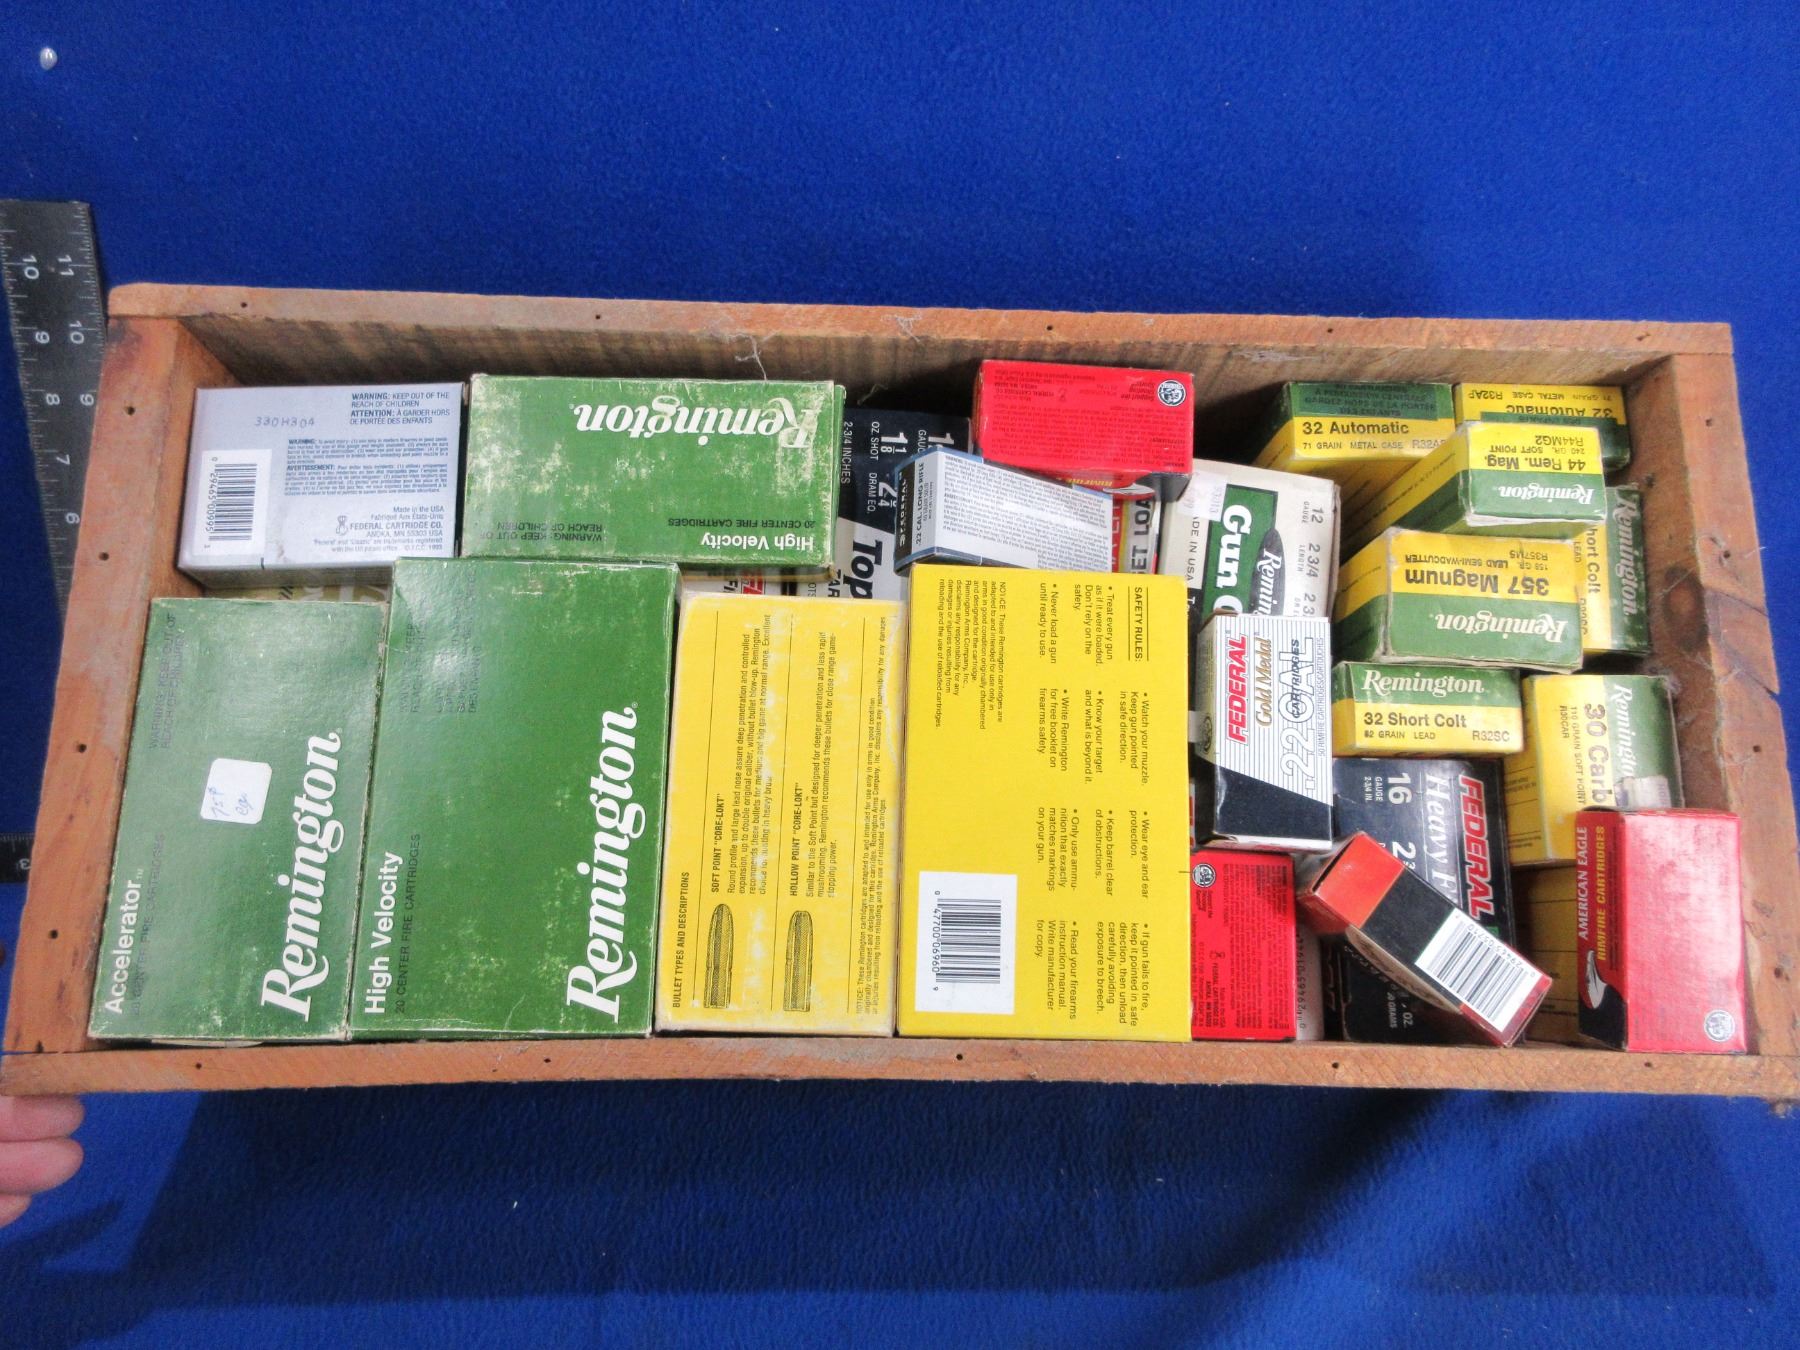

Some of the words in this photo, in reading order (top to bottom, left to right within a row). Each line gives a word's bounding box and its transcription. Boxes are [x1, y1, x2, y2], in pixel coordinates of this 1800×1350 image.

[22, 254, 40, 280] 10
[57, 254, 75, 278] 11
[35, 331, 51, 345] 9
[68, 320, 85, 345] 10
[45, 393, 61, 406] 8
[79, 393, 95, 406] 9
[351, 400, 375, 409] REACH
[376, 400, 385, 408] OF
[386, 400, 421, 408] CHILDREN
[352, 392, 392, 401] WARNING:
[392, 391, 410, 400] KEEP
[411, 391, 426, 400] OUT
[426, 391, 436, 400] OF
[437, 391, 450, 400] THE
[1511, 391, 1533, 400] CASE
[1538, 392, 1565, 400] METAL
[573, 394, 826, 448] Remington
[843, 421, 854, 446] 2-3/4
[1302, 422, 1323, 435] 32
[1329, 421, 1409, 435] Automatic
[870, 437, 880, 461] SHOT
[1303, 442, 1312, 450] 71
[1316, 442, 1342, 450] GRAIN
[1350, 442, 1377, 450] METAL
[1381, 442, 1403, 450] CASE
[1489, 445, 1517, 453] POINT
[1521, 446, 1543, 454] SOFT
[1535, 435, 1584, 446] R44MG2
[56, 454, 71, 466] 7
[841, 447, 852, 485] INCHES
[1484, 454, 1519, 470] Mag.
[1524, 458, 1562, 471] Rem.
[1567, 459, 1586, 471] 44
[867, 472, 878, 497] DRAM
[1499, 483, 1595, 506] Remington
[916, 484, 924, 511] LONG
[668, 518, 733, 528] CARTRIDGES
[736, 519, 758, 529] FIRE
[761, 520, 802, 529] CENTER
[804, 520, 816, 529] 20
[1301, 501, 1310, 524] GAUGE
[1311, 507, 1324, 524] 12
[350, 522, 383, 531] FEDERAL
[385, 521, 429, 530] CARTRIDGE
[700, 532, 769, 551] Velocity
[774, 533, 814, 551] High
[1190, 543, 1199, 554] IN
[1215, 504, 1252, 589] Gun
[1587, 527, 1601, 559] hort
[842, 540, 882, 599] Top
[1131, 545, 1148, 574] ET
[1296, 544, 1305, 572] LENGTH
[1405, 554, 1483, 566] SEMI-WADCUTTER
[1485, 559, 1508, 569] LEAD
[1612, 498, 1638, 616] Remington
[1186, 559, 1197, 582] USA
[1405, 568, 1498, 594] Magnum
[1585, 562, 1600, 593] Colt
[1084, 584, 1093, 609] Don't
[1507, 575, 1549, 596] 357
[1050, 591, 1058, 618] Never
[1106, 594, 1114, 615] Treat
[1134, 587, 1143, 624] SAFETY
[1050, 619, 1058, 638] load
[1083, 610, 1093, 626] rely
[1105, 617, 1114, 642] every
[1434, 611, 1568, 643] Remington
[1084, 627, 1092, 639] on
[1134, 626, 1143, 662] RULES:
[1049, 647, 1057, 664] gun
[1084, 640, 1093, 655] the
[1105, 643, 1113, 660] gun
[1253, 637, 1272, 687] Medal
[1227, 635, 1248, 745] FEDERAL
[1277, 637, 1315, 724] CAL
[1290, 639, 1301, 719] CARTRIDGES
[1362, 669, 1486, 697] Remington
[1254, 688, 1273, 728] Gold
[1364, 712, 1383, 726] 32
[1387, 712, 1430, 727] Short
[1434, 713, 1467, 728] Colt
[1584, 703, 1608, 737] 30
[1378, 731, 1406, 740] GRAIN
[1413, 731, 1436, 740] LEAD
[1472, 730, 1510, 742] R32SC
[1571, 722, 1581, 750] GRAIN
[1611, 683, 1637, 777] Remingto
[1574, 752, 1584, 775] SOFT
[1375, 776, 1383, 801] GAUGE
[1387, 772, 1412, 805] 16
[1576, 778, 1587, 805] POINT
[1423, 773, 1451, 864] Heavy
[791, 838, 801, 861] POINT
[1459, 773, 1495, 921] FEDERAL
[1576, 826, 1588, 866] EAGLE
[405, 833, 421, 911] CARTRIDGES
[566, 706, 647, 1025] Remington
[712, 848, 722, 871] POINT
[1595, 825, 1607, 904] CARTRIDGES
[261, 731, 343, 1023] Remington
[711, 873, 720, 893] SOFT
[789, 863, 799, 897] HOLLOW
[371, 851, 403, 950] Velocity
[677, 872, 690, 929] DESCRIPTIONS
[1577, 870, 1589, 940] AMERICAN
[400, 915, 413, 942] FIRE
[931, 908, 941, 938] 47700
[1595, 908, 1607, 961] RIMFIRE
[104, 879, 141, 1015] Accelerator
[676, 930, 686, 948] AND
[1070, 929, 1078, 953] Read
[1106, 921, 1116, 962] carefully
[673, 949, 685, 975] TYPES
[931, 942, 940, 973] 06960
[1068, 957, 1077, 978] your
[396, 946, 411, 996] CENTER
[364, 957, 393, 1014] High
[672, 977, 682, 1008] BULLET
[1106, 964, 1116, 1004] avoiding
[395, 1000, 405, 1013] 20
[1069, 980, 1078, 1020] firearms
[1119, 991, 1127, 1024] unload
[1387, 1001, 1398, 1028] GRAMS
